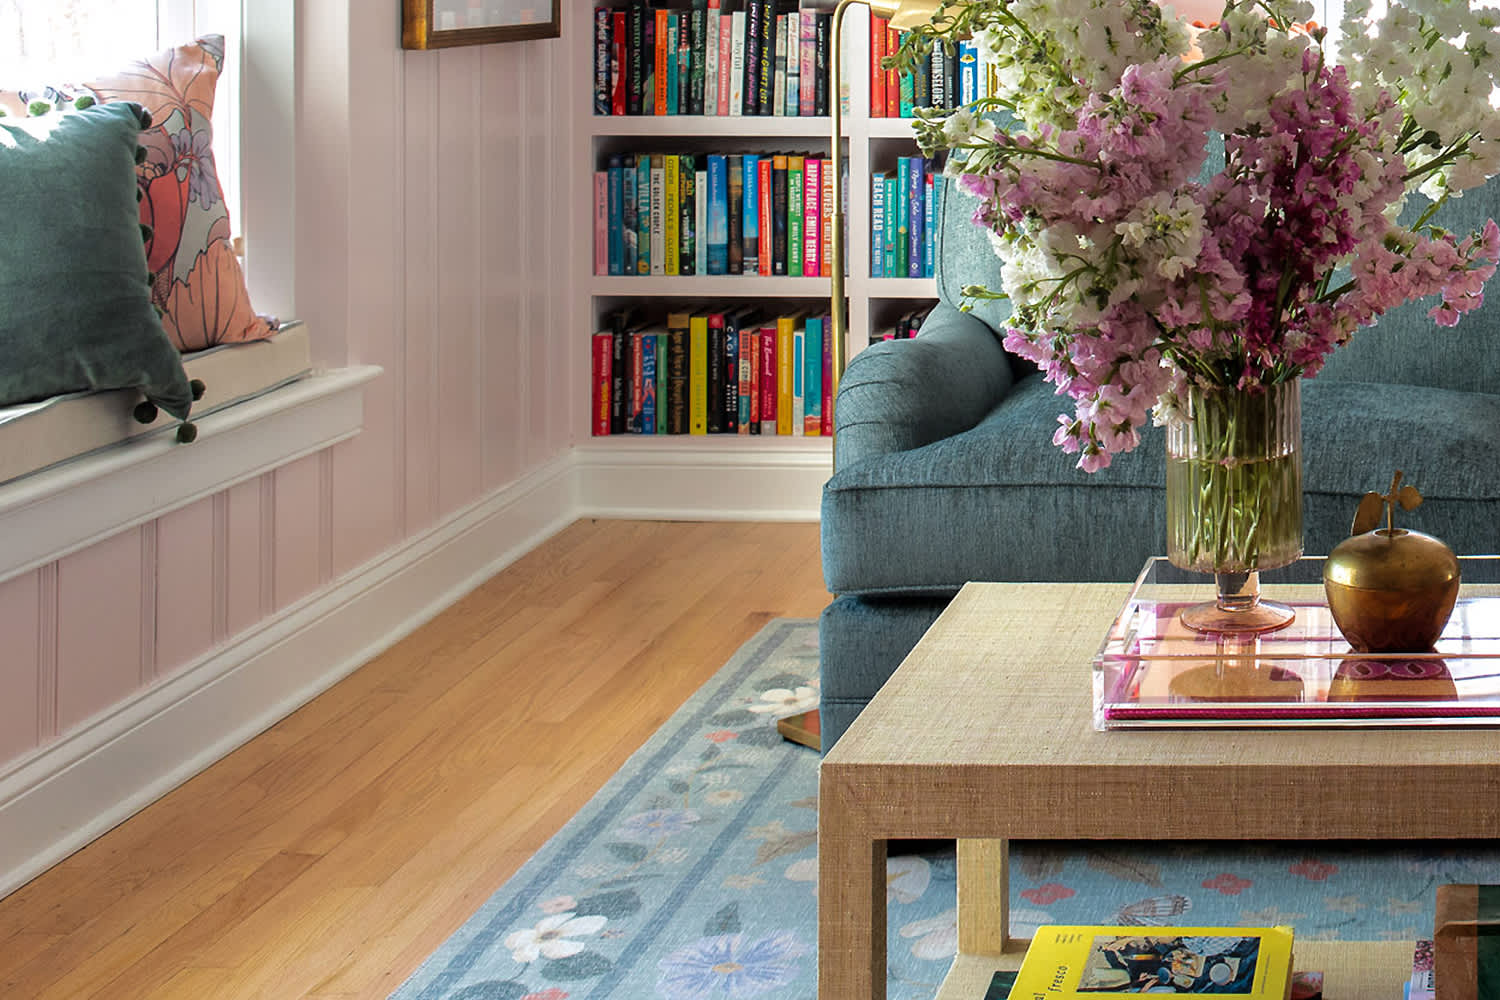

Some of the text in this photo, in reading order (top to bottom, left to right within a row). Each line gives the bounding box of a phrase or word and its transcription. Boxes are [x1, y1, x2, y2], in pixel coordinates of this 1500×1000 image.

[733, 40, 742, 70] Joyful
[760, 59, 769, 85] GUEST
[932, 52, 944, 105] COUNSELORS
[760, 88, 768, 104] LIST
[638, 183, 650, 212] VILLA
[873, 177, 883, 231] BEACH READ
[806, 164, 816, 262] HAPPY PLACE EMILY HENRY
[824, 165, 832, 264] BOOK LOVERS EMILY HENRY
[1048, 966, 1068, 992] fresco
